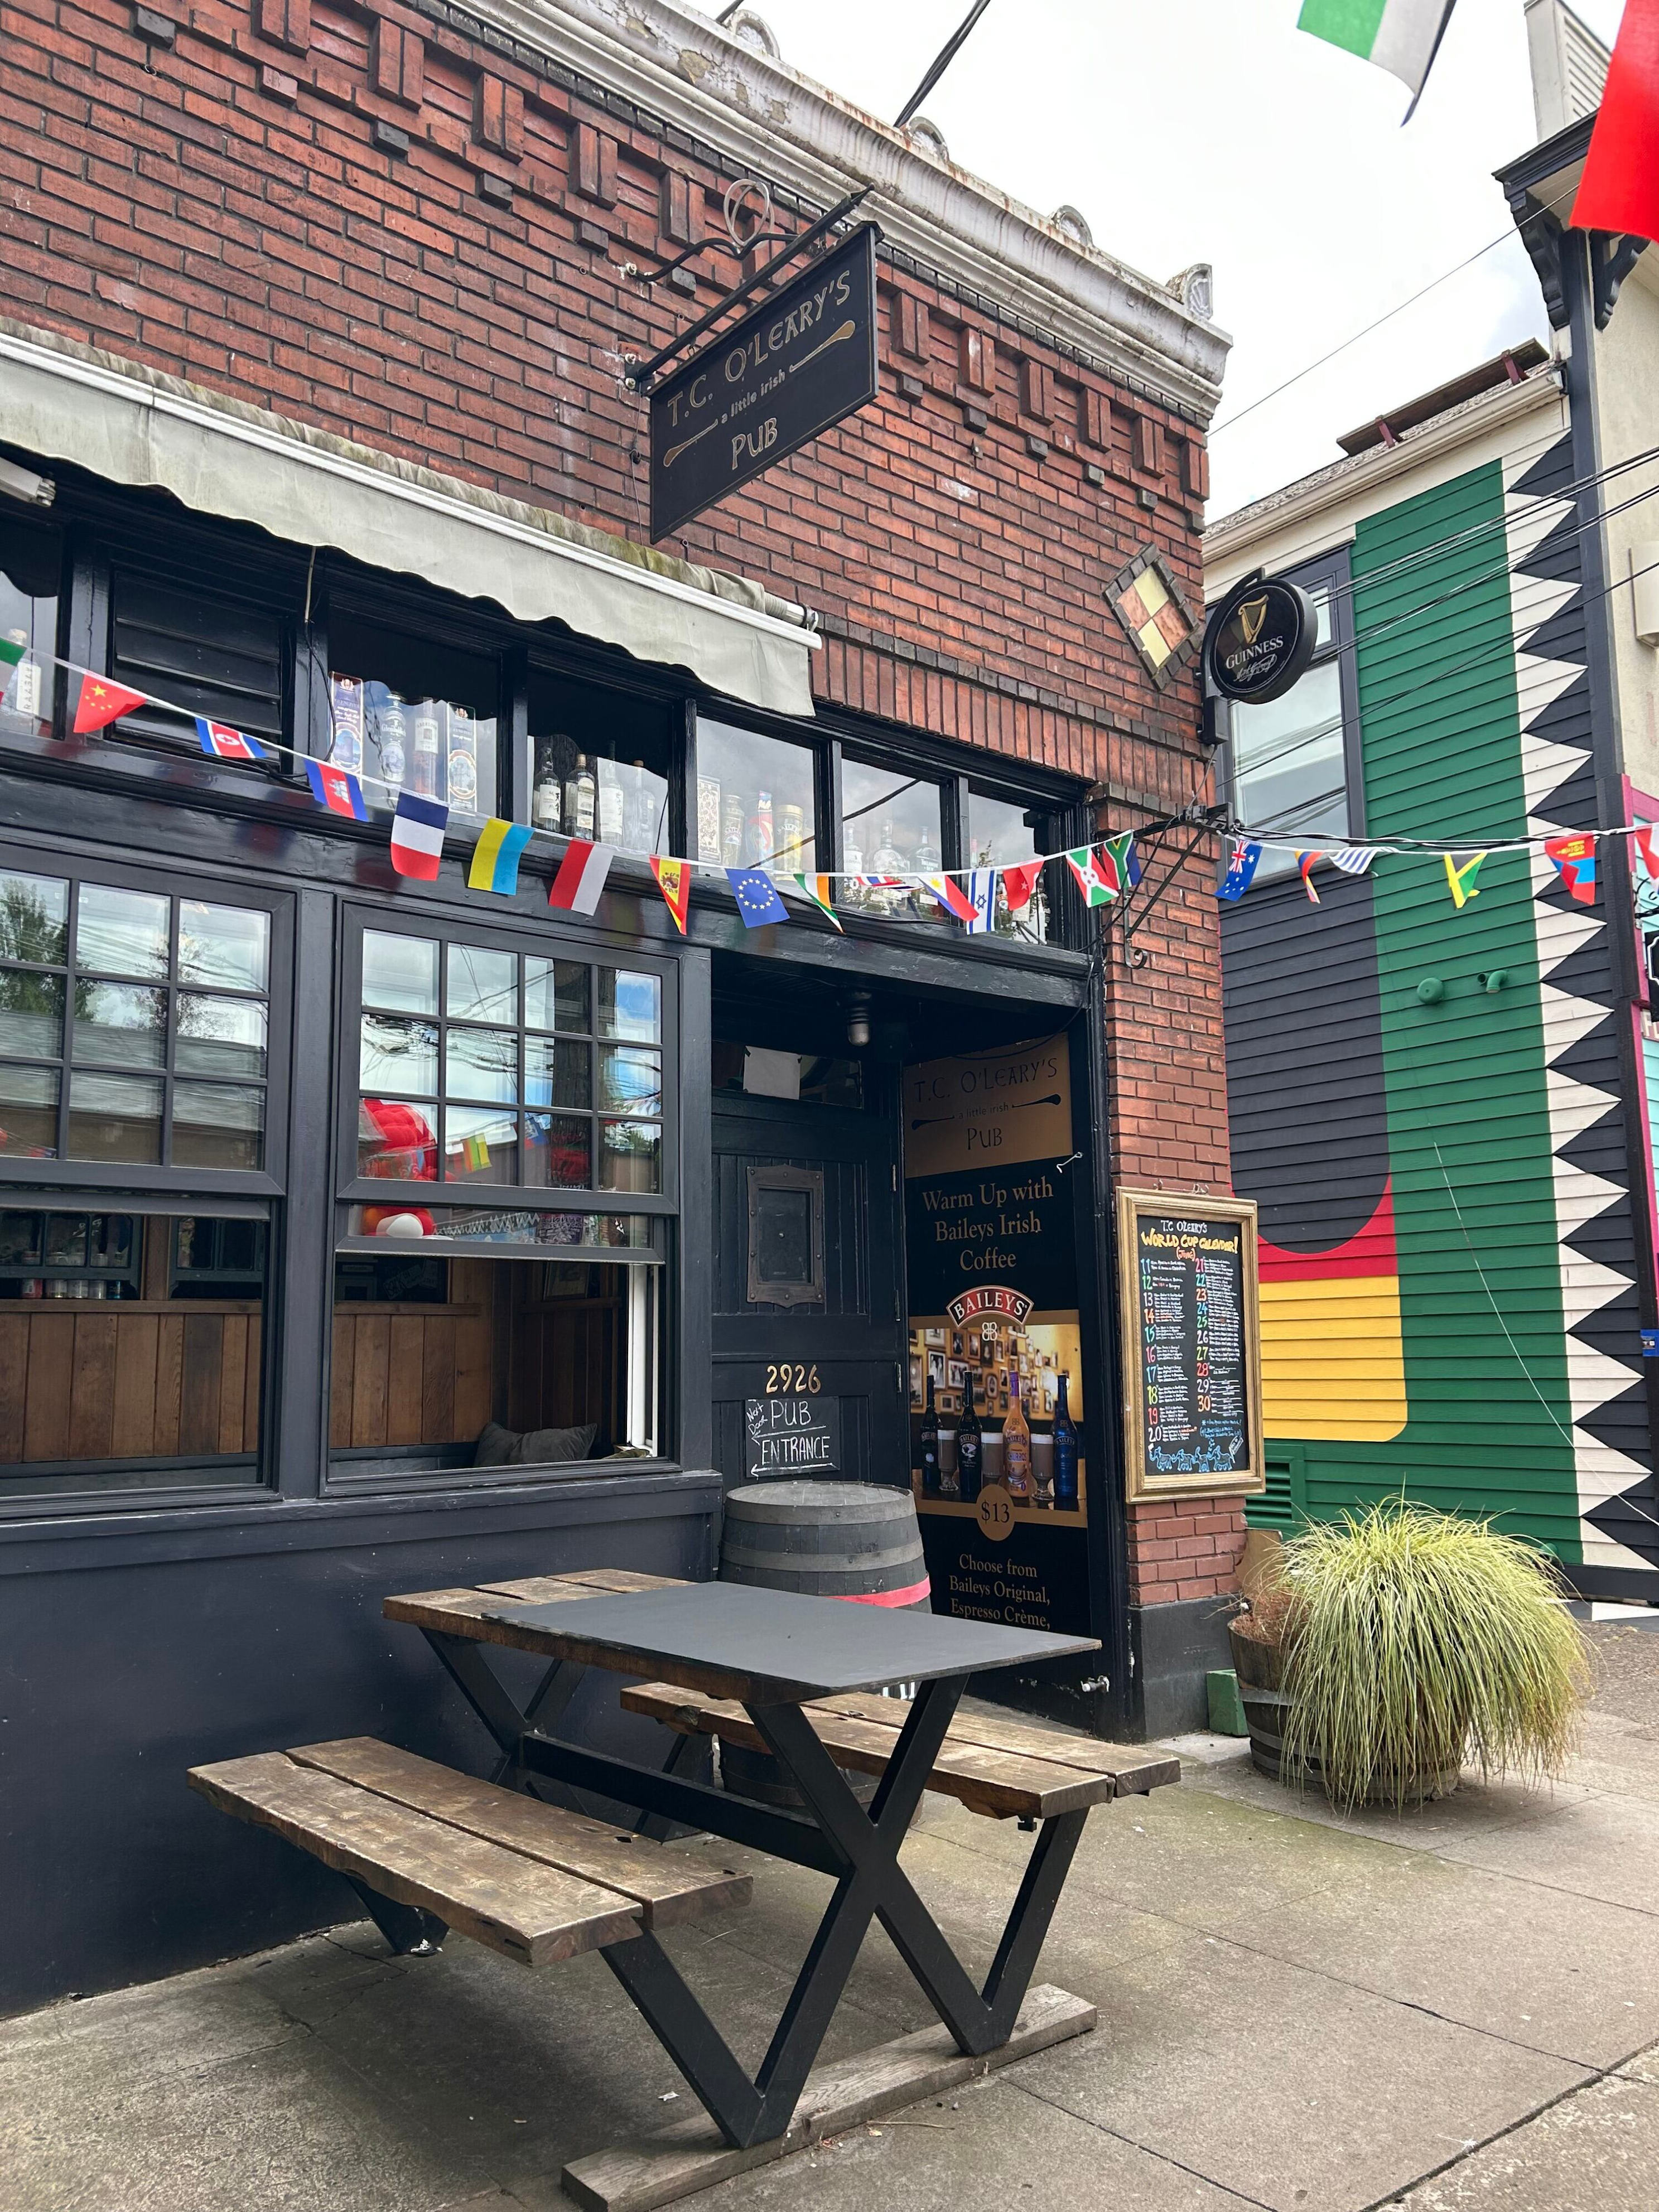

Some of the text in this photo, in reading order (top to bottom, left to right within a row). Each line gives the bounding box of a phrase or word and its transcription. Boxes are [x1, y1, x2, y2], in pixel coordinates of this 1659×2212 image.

[667, 270, 851, 427] T.C. O'LEARY'S
[721, 369, 785, 424] a little irish
[731, 417, 778, 470] PUB
[1226, 636, 1284, 669] GUINNESS
[914, 1057, 1058, 1103] T.C. O'LEARY'S
[966, 1106, 986, 1118] little
[990, 1102, 1009, 1113] irish
[967, 1127, 1002, 1150] PUB
[923, 1176, 1053, 1211] Warm Up with
[935, 1211, 1041, 1242] Baileys Irish
[1141, 1228, 1179, 1248] WORLD
[1180, 1234, 1199, 1249] CUP
[959, 1248, 1016, 1271] Coffee
[1141, 1258, 1151, 1274] 11
[1142, 1275, 1152, 1290] 12
[954, 1290, 1025, 1320] BAILEYS
[1144, 1292, 1153, 1307] 13
[1144, 1308, 1155, 1324] 14
[1197, 1316, 1208, 1329] 25
[1197, 1330, 1209, 1344] 26
[1197, 1346, 1208, 1361] 27
[766, 1364, 821, 1394] 2926
[770, 1400, 812, 1428] PUB
[1148, 1408, 1158, 1425] 19
[761, 1436, 831, 1466] ENTRANCE
[981, 1499, 1010, 1524] $13
[959, 1553, 1037, 1578] Choose from
[949, 1576, 1051, 1607] Baileys Original,
[951, 1598, 1051, 1630] Espresso Crème,
